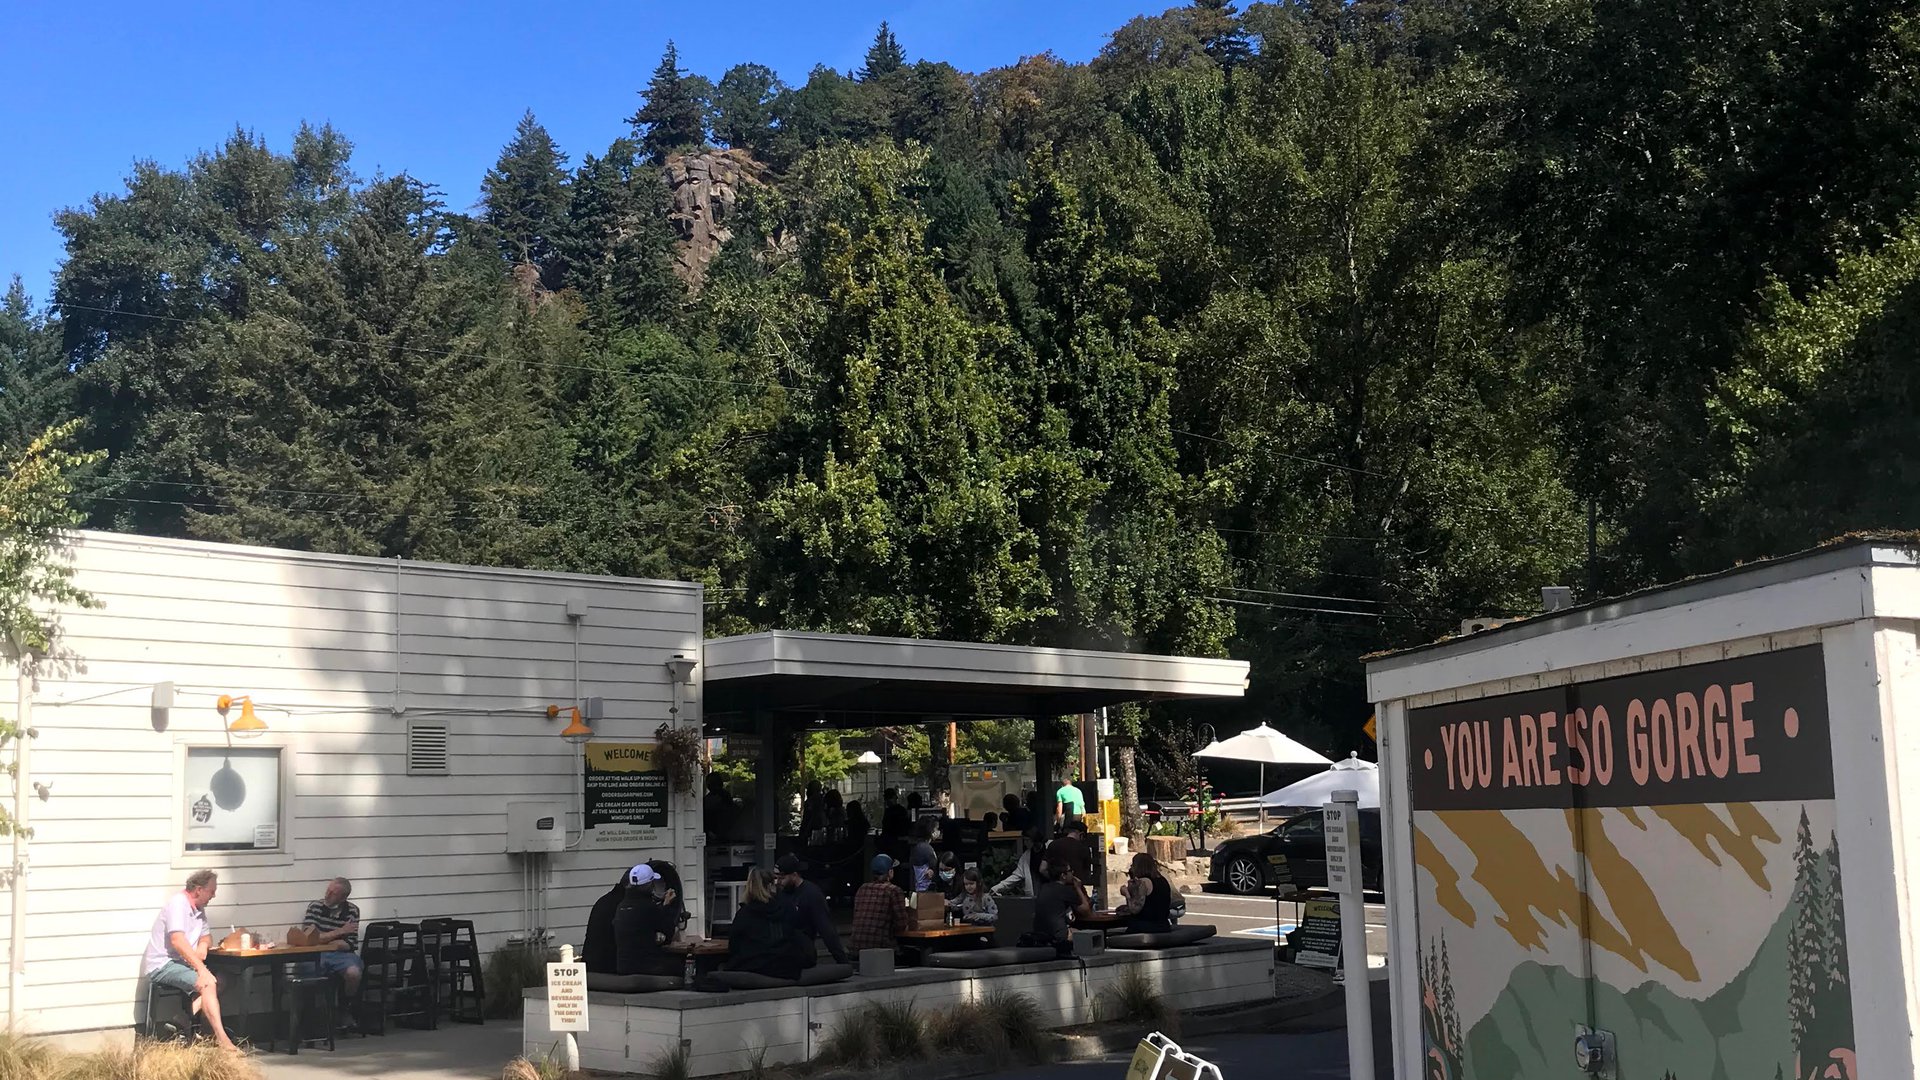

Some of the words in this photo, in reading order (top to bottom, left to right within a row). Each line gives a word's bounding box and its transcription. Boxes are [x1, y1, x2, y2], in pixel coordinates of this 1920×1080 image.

[1440, 720, 1492, 791] YOU
[1502, 711, 1562, 788] ARE
[1564, 704, 1614, 786] SO
[1626, 682, 1761, 786] GORGE
[604, 748, 651, 761] WELCOME
[1327, 810, 1341, 820] STOP
